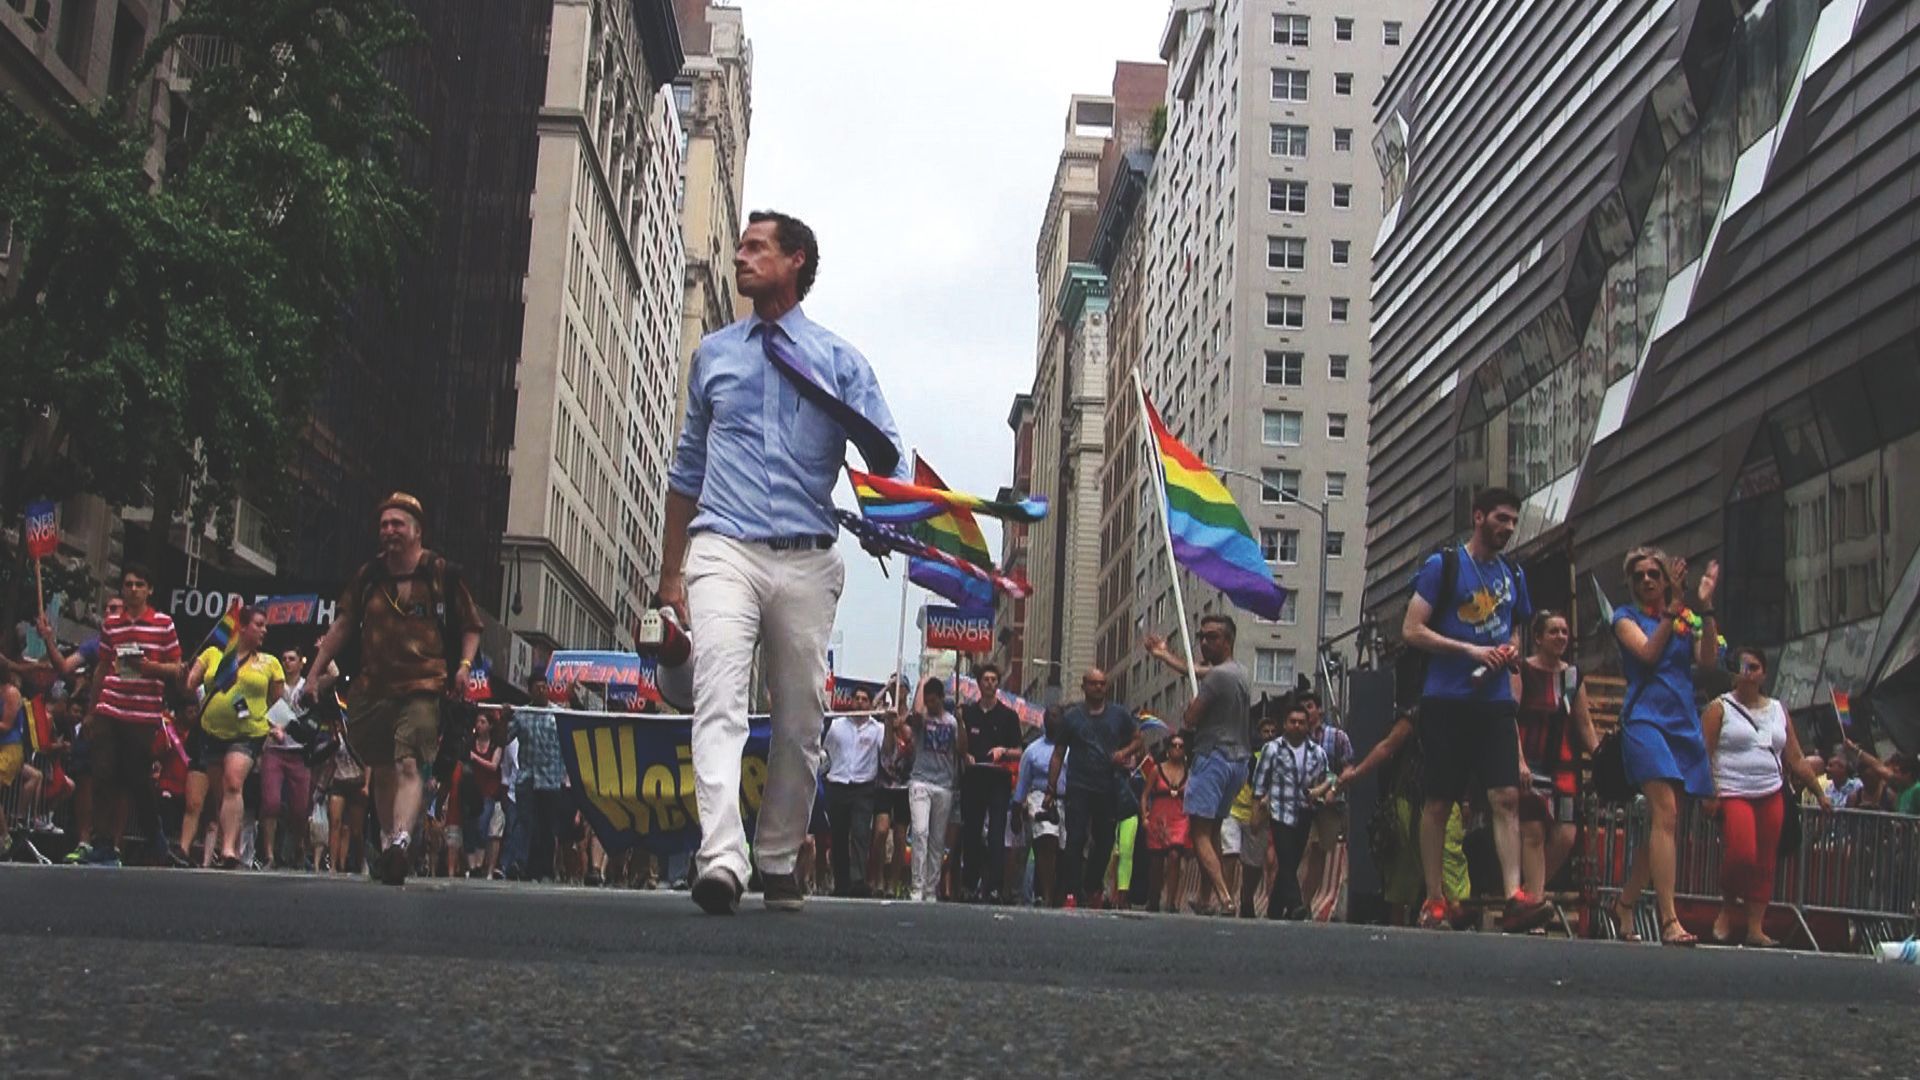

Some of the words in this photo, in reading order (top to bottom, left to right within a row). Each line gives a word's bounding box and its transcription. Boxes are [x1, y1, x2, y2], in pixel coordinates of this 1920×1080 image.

[170, 589, 244, 618] FOOD
[929, 615, 990, 632] WEINER
[934, 628, 990, 642] MAYOR
